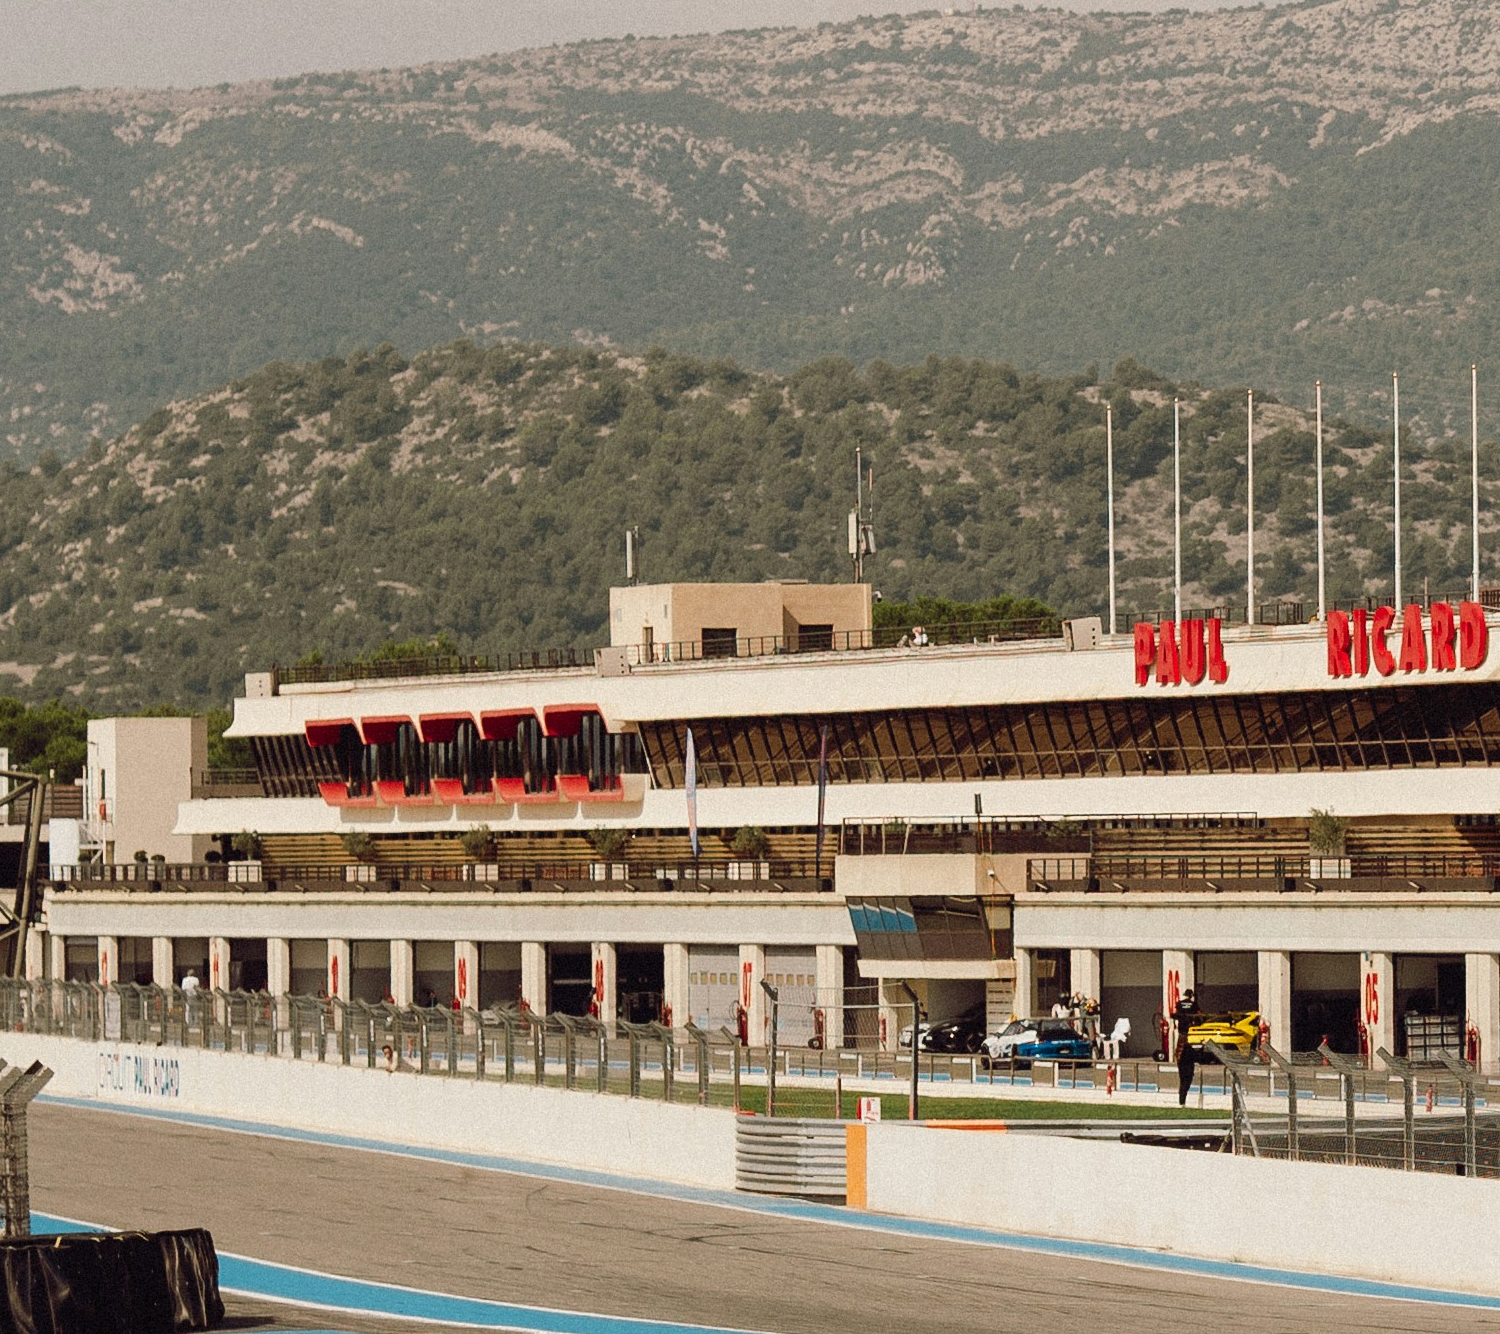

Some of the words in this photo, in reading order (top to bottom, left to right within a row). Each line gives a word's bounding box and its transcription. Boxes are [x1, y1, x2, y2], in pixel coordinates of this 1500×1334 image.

[1133, 617, 1229, 687] PAUL
[1326, 600, 1488, 678] RICARD
[743, 962, 753, 1008] 07
[1168, 969, 1181, 1017] 06
[1366, 972, 1379, 1026] 05
